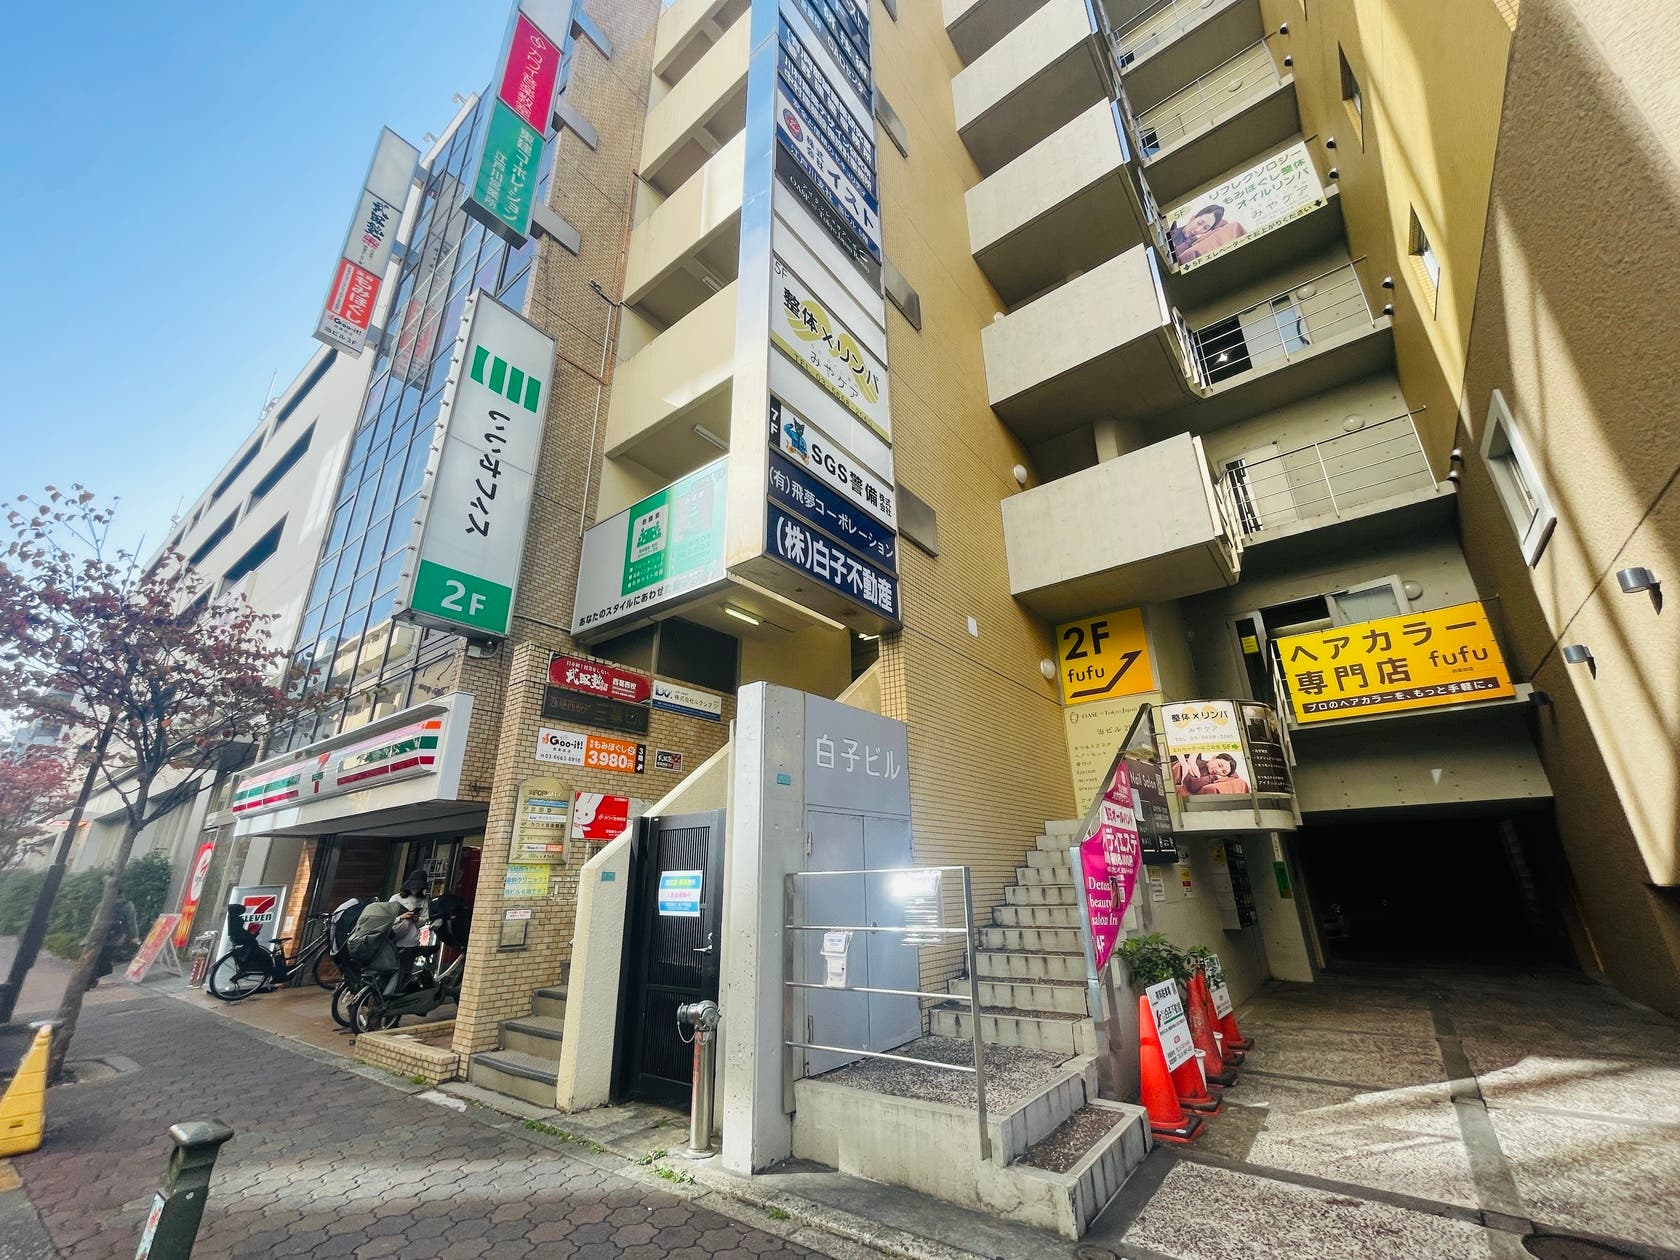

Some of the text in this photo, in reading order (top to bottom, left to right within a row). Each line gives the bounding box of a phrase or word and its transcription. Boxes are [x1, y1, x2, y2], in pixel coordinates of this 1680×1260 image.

[514, 46, 543, 122] カワイ音楽教室
[504, 126, 535, 221] 東建コーポレーション
[1208, 149, 1302, 201] リフレクソロジー
[1222, 158, 1306, 204] もみほぐし整体
[1237, 166, 1311, 210] オイルリンパ
[827, 168, 874, 229] イスト
[1173, 209, 1186, 220] 5F
[1205, 205, 1313, 261] エレベーターでお上がりください
[774, 260, 788, 279] 5F
[345, 273, 372, 324] もみほぐし
[770, 407, 779, 434] 7F
[465, 409, 511, 537] いいオフィス
[811, 442, 879, 509] SGS警備
[769, 466, 894, 558] (有)飛夢コーポレーション
[776, 515, 894, 613] (株)白子不動産
[440, 579, 487, 617] 2F
[1063, 620, 1110, 661] 2F
[1290, 620, 1478, 663] ヘアカラー
[566, 667, 605, 691] 武田塾
[1067, 665, 1106, 683] fufu
[1294, 644, 1489, 696] 専門店 fufu
[1307, 680, 1495, 712] プロのヘアカラーを、もっと手軽に。
[549, 735, 584, 750] Goo-it!
[588, 750, 634, 769] 3,980円
[593, 740, 627, 753] もみほぐし
[816, 734, 900, 780] 白子ビル
[1089, 894, 1112, 912] beauty
[1091, 913, 1109, 925] salon
